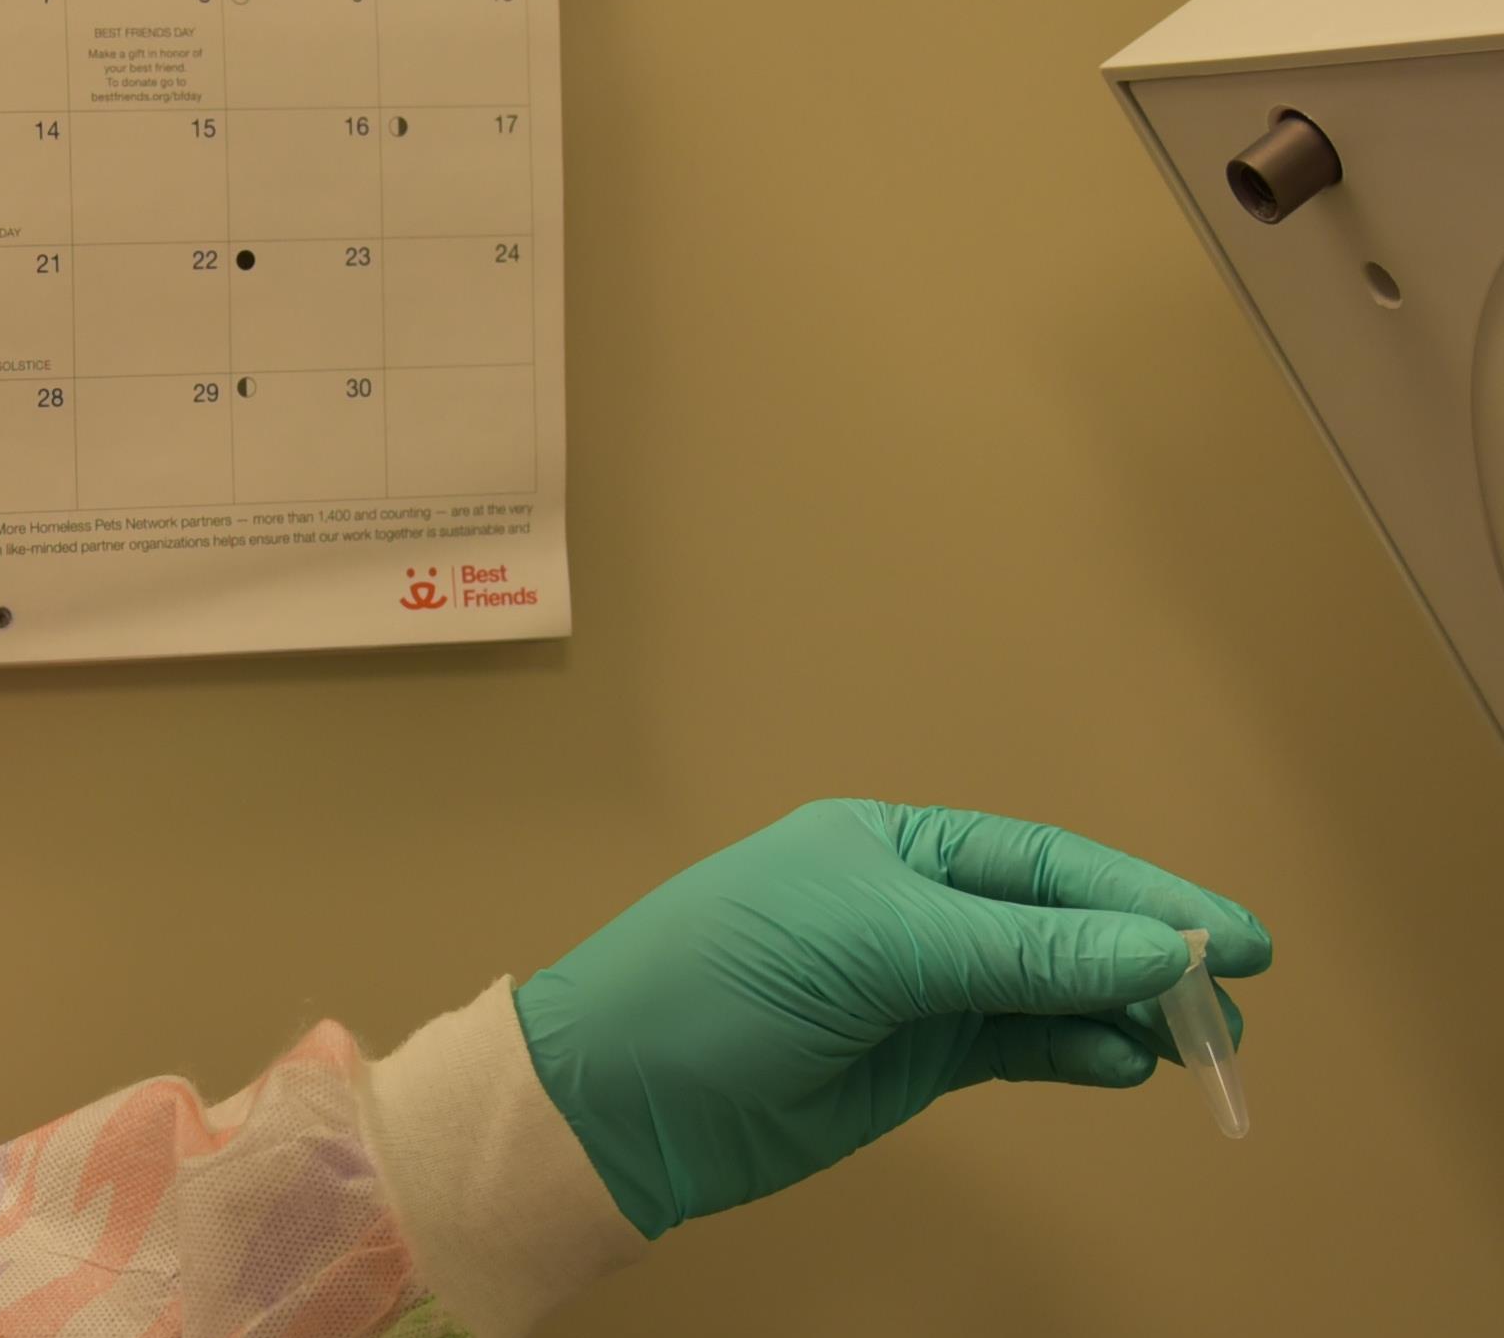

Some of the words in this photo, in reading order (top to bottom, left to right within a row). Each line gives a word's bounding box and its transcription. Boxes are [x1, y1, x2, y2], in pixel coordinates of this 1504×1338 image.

[94, 28, 121, 39] BEST
[125, 28, 171, 38] FRIENDS
[174, 28, 196, 37] DAY
[88, 49, 116, 59] Make
[119, 51, 125, 59] a
[129, 49, 145, 61] gift
[148, 49, 157, 58] in
[160, 49, 189, 58] honor
[192, 49, 202, 58] of
[35, 120, 60, 140] 14
[191, 118, 216, 139] 15
[345, 116, 370, 136] 16
[495, 114, 518, 134] 17
[0, 228, 21, 238] DAY
[36, 253, 59, 274] 21
[192, 249, 218, 270] 22
[345, 246, 371, 267] 23
[495, 243, 520, 263] 24
[37, 387, 64, 408] 28
[193, 382, 219, 403] 29
[346, 377, 372, 398] 30
[30, 522, 91, 534] Homeless
[95, 520, 122, 531] Pets
[126, 518, 177, 530] Network
[180, 515, 232, 530] partners
[253, 514, 284, 526] more
[288, 512, 314, 524] than
[319, 511, 350, 523] 1,400
[354, 510, 377, 521] and
[380, 507, 431, 521] counting
[451, 506, 470, 517] are
[473, 505, 484, 516] at
[488, 505, 507, 516] the
[509, 505, 533, 517] very
[6, 541, 78, 555] like-minded
[81, 540, 124, 554] partner
[129, 535, 210, 552] organizations
[213, 534, 246, 549] helps
[249, 533, 290, 545] ensure
[293, 530, 316, 543] that
[319, 532, 339, 542] our
[343, 529, 372, 541] work
[375, 527, 423, 542] together
[427, 527, 436, 538] is
[439, 524, 505, 538] sustainable
[508, 523, 530, 534] and
[462, 565, 508, 583] Best
[463, 588, 538, 607] Friends
